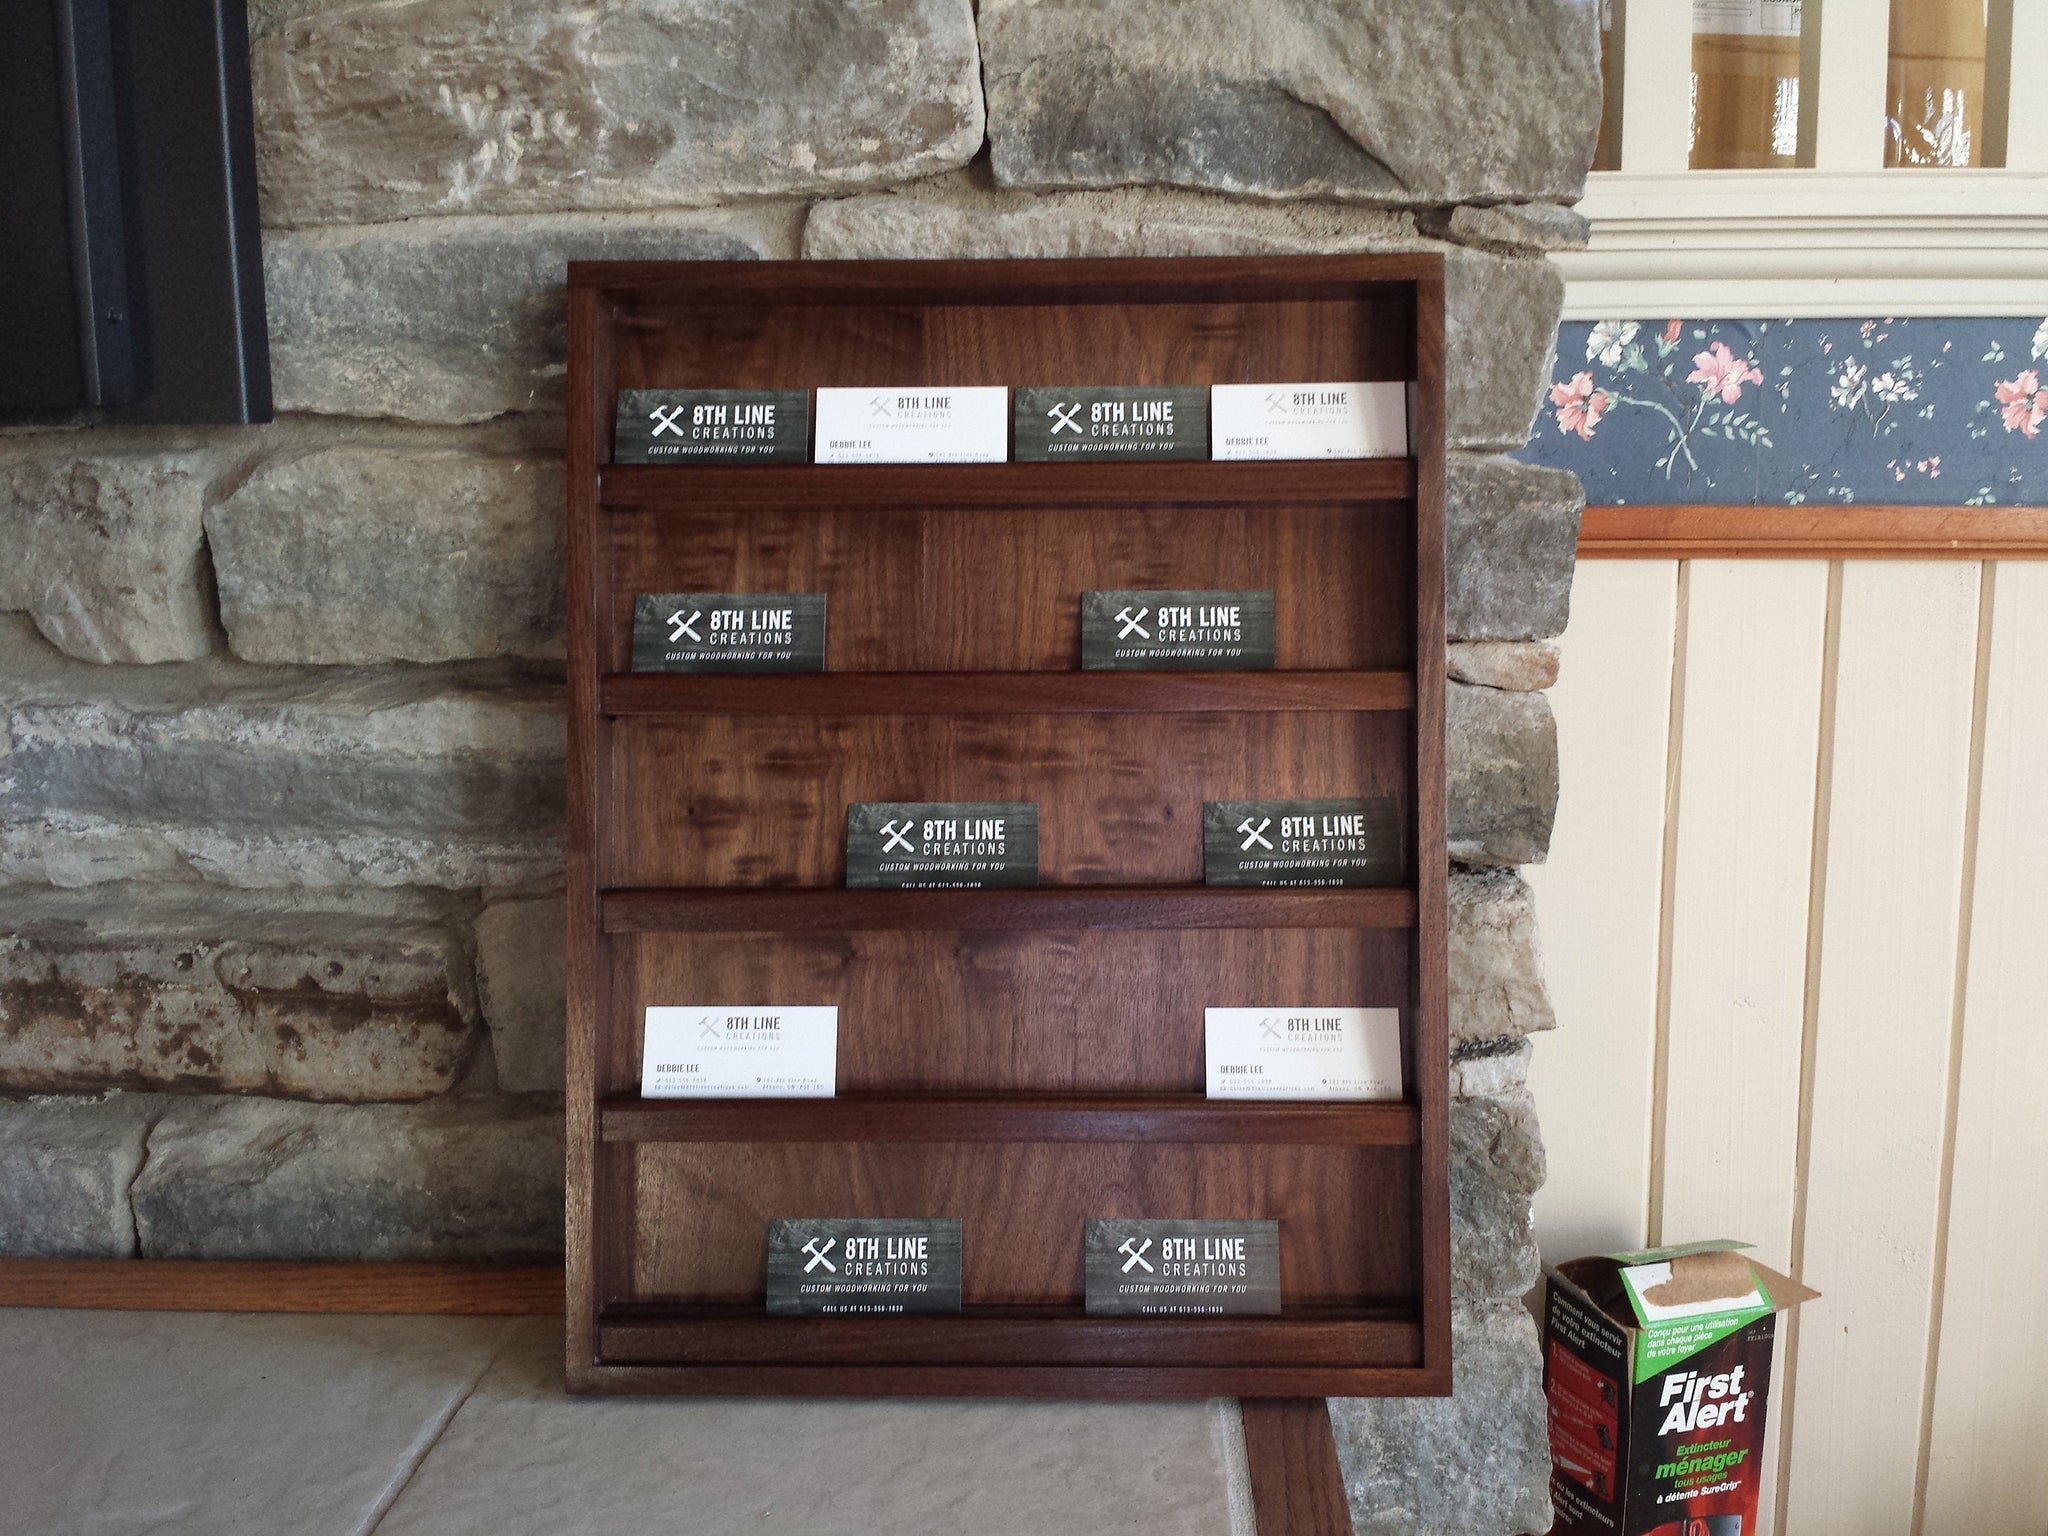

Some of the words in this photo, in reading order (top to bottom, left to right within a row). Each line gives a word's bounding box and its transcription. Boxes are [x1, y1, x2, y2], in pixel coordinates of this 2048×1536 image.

[898, 397, 919, 409] 8TH
[925, 397, 951, 409] LINE
[1294, 393, 1315, 405] 8TH
[1321, 392, 1347, 404] LINE
[693, 405, 725, 425] 8TH
[735, 405, 775, 425] LINE
[1091, 402, 1124, 422] 8TH
[1133, 401, 1173, 422] LINE
[693, 427, 775, 439] CREATIONS
[1092, 424, 1174, 436] CREATIONS
[1082, 443, 1137, 451] WOODWORKING
[710, 610, 743, 630] 8TH
[752, 610, 792, 630] LINE
[1158, 607, 1191, 627] 8TH
[1200, 607, 1240, 627] LINE
[710, 633, 792, 645] CREATIONS
[1159, 630, 1241, 642] CREATIONS
[700, 652, 754, 660] WOODWORKING
[1115, 649, 1145, 657] CUSTOM
[923, 820, 956, 840] 8TH
[965, 820, 1005, 840] LINE
[1281, 817, 1314, 837] 8TH
[1323, 815, 1364, 836] LINE
[923, 843, 1005, 855] CREATIONS
[1282, 839, 1365, 852] CREATIONS
[880, 863, 910, 871] CUSTOM
[913, 863, 969, 871] WOODWORKING
[1239, 861, 1269, 869] CUSTOM
[1273, 860, 1329, 868] WOODWORKING
[727, 1017, 748, 1030] 8TH
[754, 1017, 780, 1029] LINE
[1288, 1019, 1309, 1031] 8TH
[1315, 1019, 1341, 1031] LINE
[657, 1064, 684, 1072] DEBBIE
[687, 1064, 699, 1072] LEE
[1221, 1066, 1248, 1074] DEBBIE
[1250, 1066, 1263, 1074] LEE
[846, 1238, 879, 1259] 8TH
[887, 1238, 927, 1259] LINE
[1163, 1239, 1195, 1260] 8TH
[1205, 1239, 1245, 1260] LINE
[845, 1263, 927, 1276] CREATIONS
[1163, 1263, 1246, 1276] CREATIONS
[835, 1284, 890, 1292] WOODWORKING
[894, 1284, 908, 1292] FOR
[913, 1284, 927, 1292] YOU
[1119, 1285, 1149, 1293] CUSTOM
[1154, 1285, 1209, 1293] WOODWORKING
[1213, 1285, 1228, 1293] FOR
[1232, 1285, 1246, 1293] YOU
[1553, 1292, 1583, 1319] Comment
[1584, 1316, 1600, 1331] vous
[1601, 1328, 1622, 1345] servir
[1552, 1306, 1560, 1316] de
[1562, 1313, 1579, 1331] votre
[1582, 1328, 1621, 1358] extincteur
[1552, 1317, 1566, 1334] First
[1568, 1331, 1585, 1349] Alert
[1648, 1329, 1671, 1338] Conçu
[1672, 1325, 1688, 1338] pour
[1705, 1318, 1738, 1329] utilisation
[1648, 1339, 1664, 1348] dans
[1666, 1336, 1692, 1346] chaque
[1647, 1349, 1656, 1358] de
[1658, 1347, 1675, 1356] votre
[1678, 1344, 1696, 1354] foyer
[1660, 1365, 1745, 1407] First
[1658, 1391, 1749, 1436] Alert
[1676, 1439, 1731, 1456] Extincteur
[1655, 1449, 1749, 1479] ménager
[1674, 1479, 1694, 1488] tous
[1696, 1471, 1727, 1483] usages
[1656, 1495, 1662, 1504] à
[1665, 1489, 1698, 1503] détente
[1576, 1497, 1614, 1528] extincteurs
